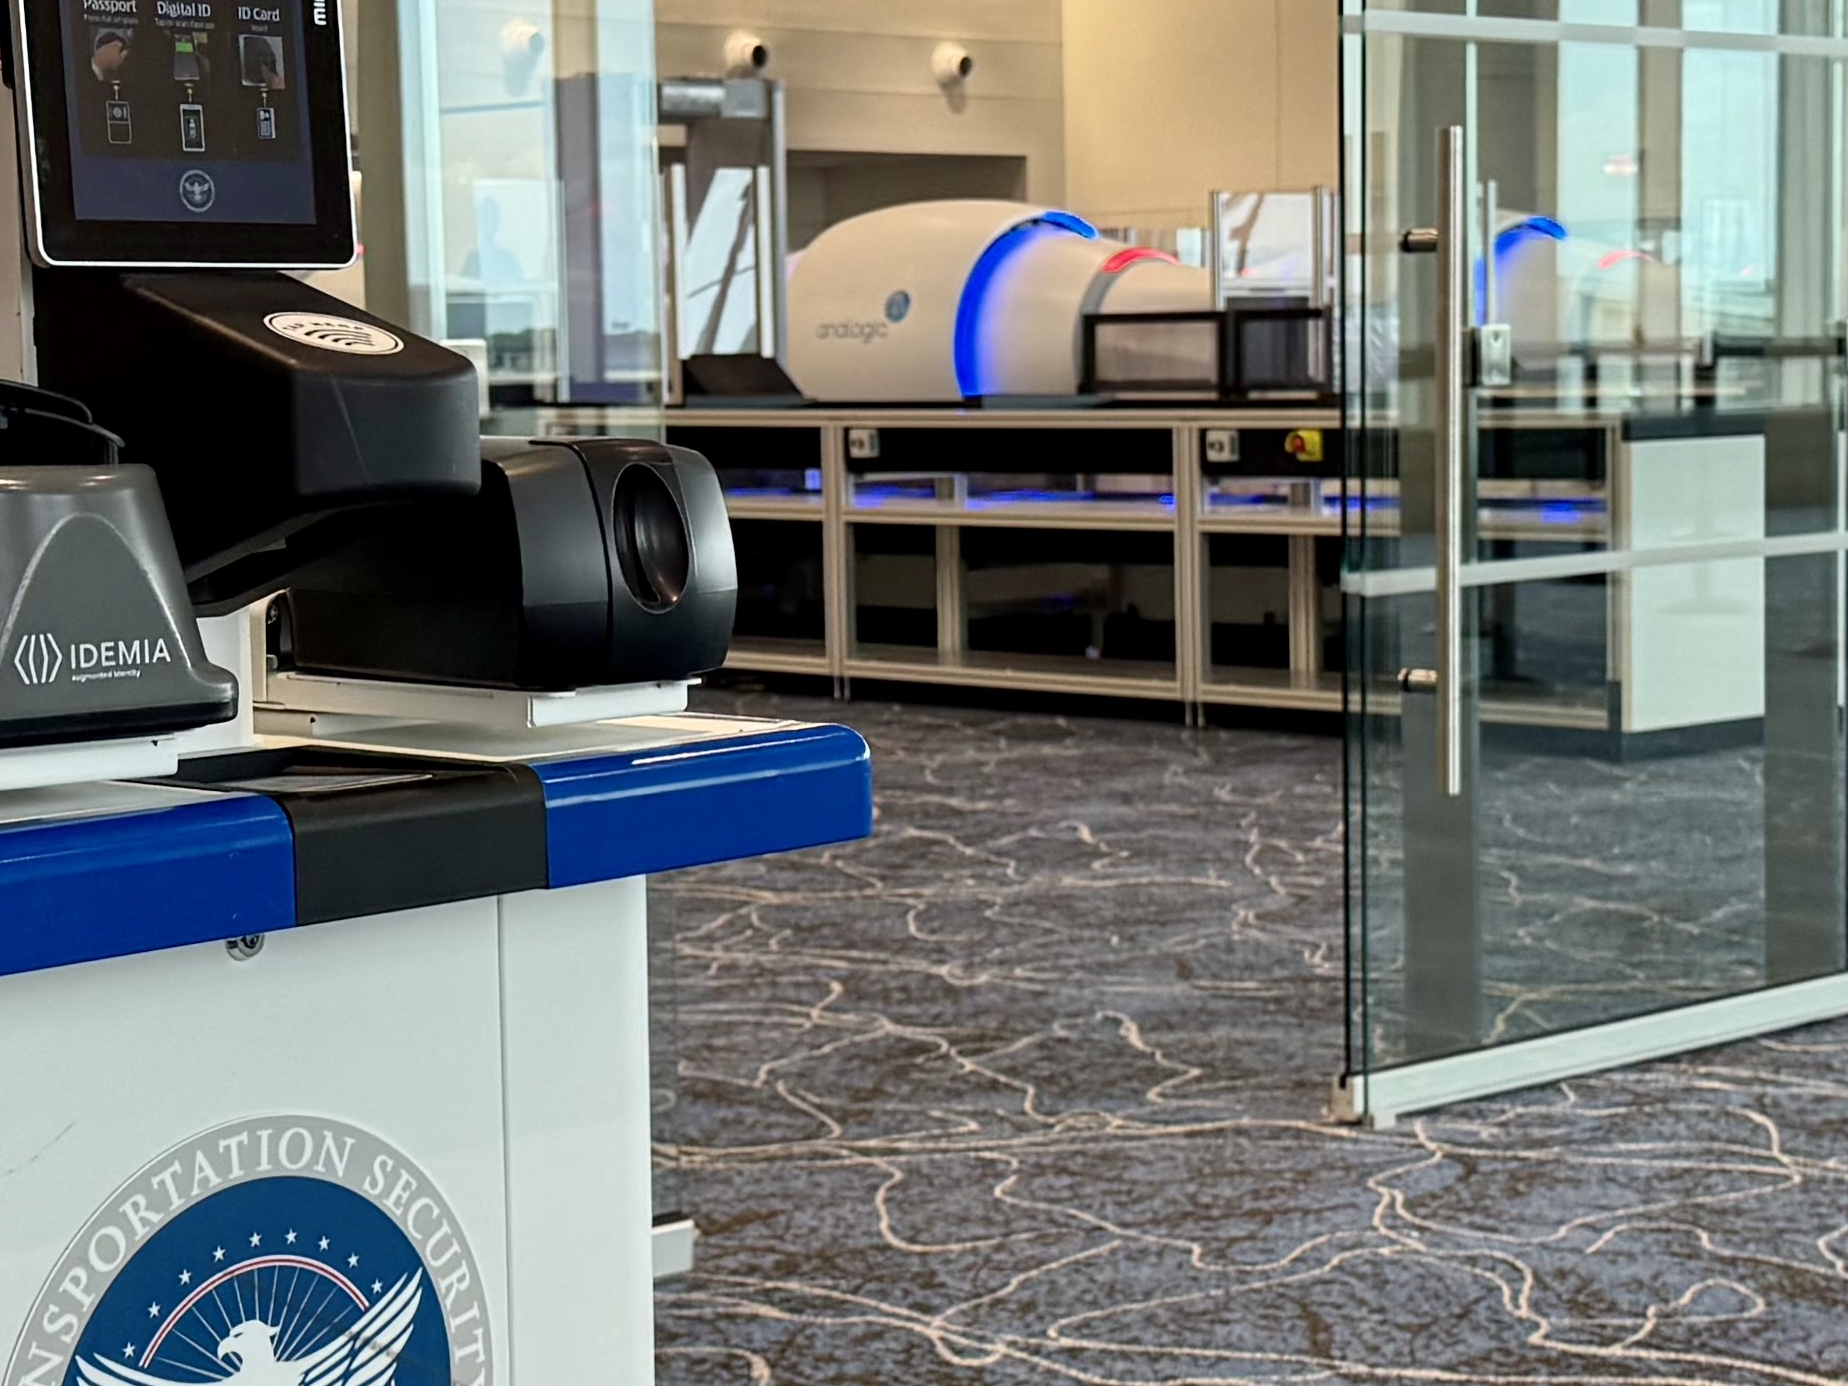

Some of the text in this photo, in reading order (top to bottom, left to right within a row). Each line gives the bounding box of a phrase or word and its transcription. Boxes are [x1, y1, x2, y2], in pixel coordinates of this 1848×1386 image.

[156, 1, 212, 18] Digital ID
[238, 6, 280, 22] ID Card
[70, 638, 171, 669] IDEMIA
